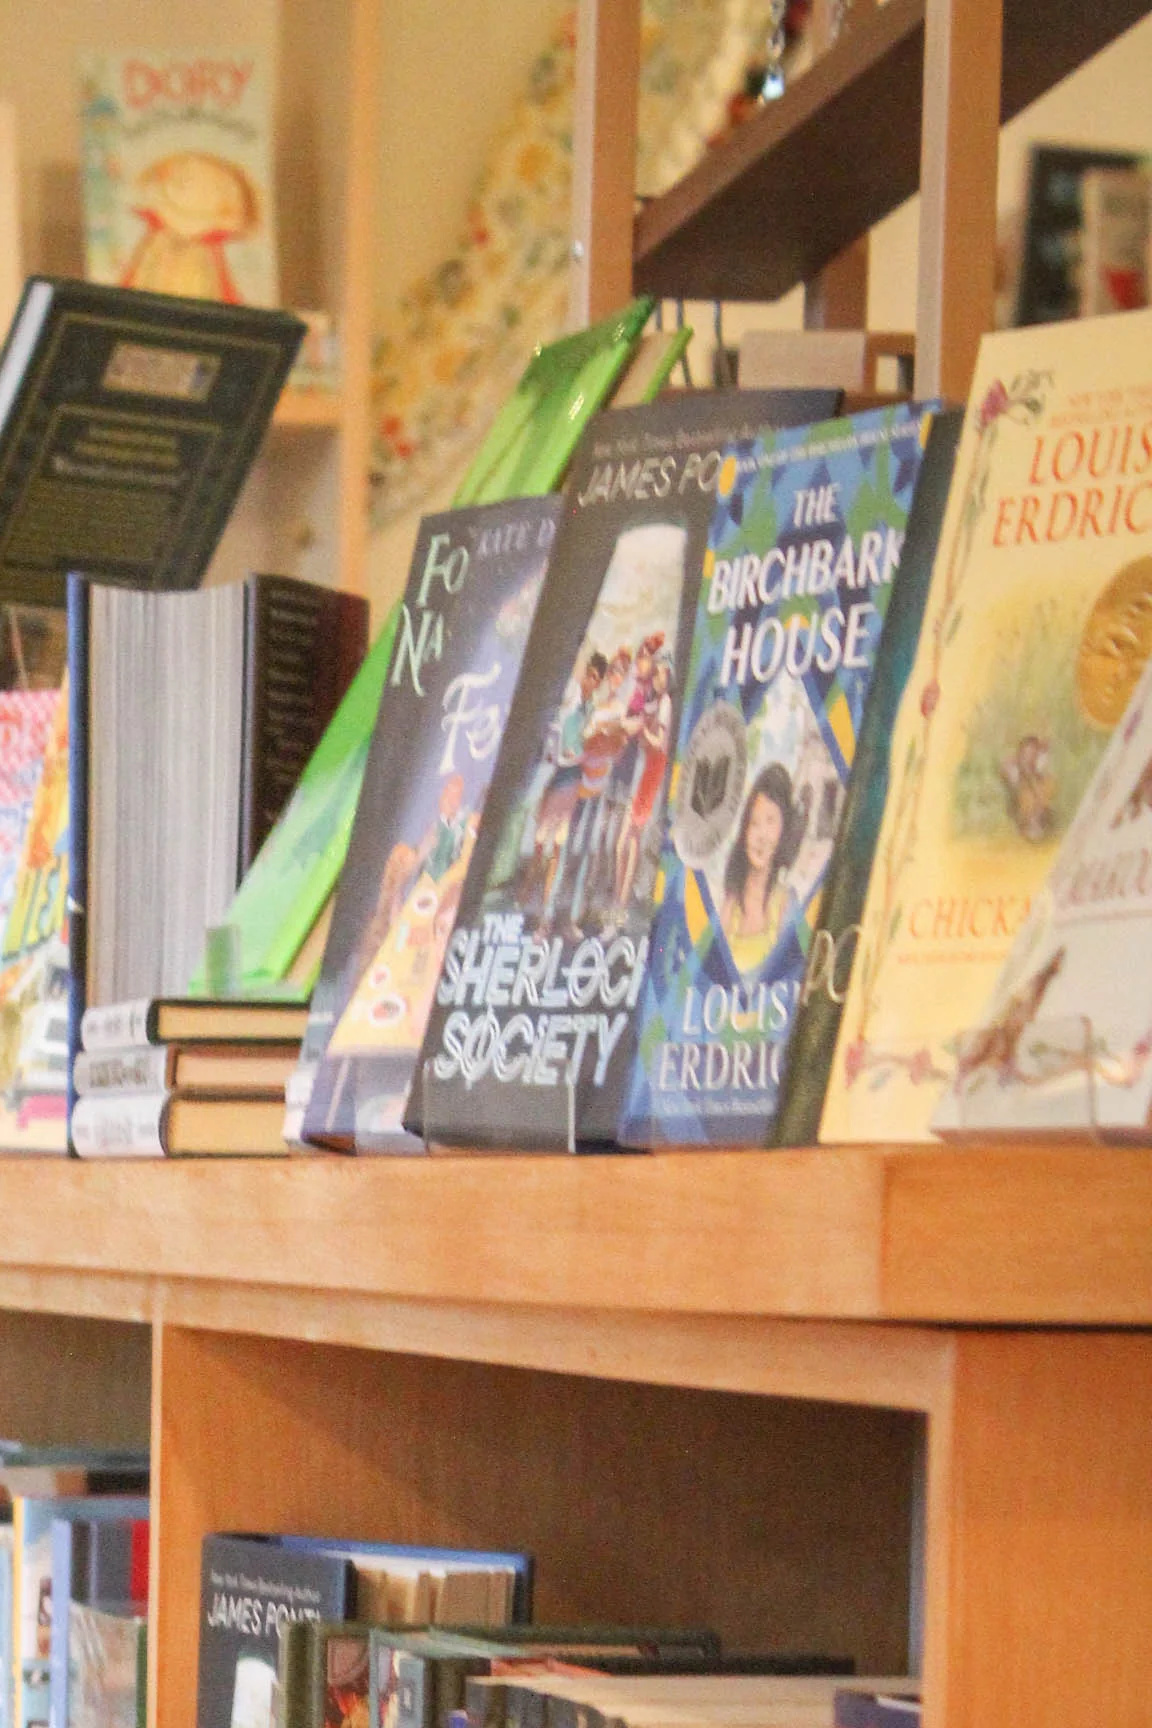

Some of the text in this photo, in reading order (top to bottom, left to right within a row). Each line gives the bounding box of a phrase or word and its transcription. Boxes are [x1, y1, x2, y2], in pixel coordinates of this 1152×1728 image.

[578, 456, 677, 508] JAMES
[793, 482, 840, 527] THE
[719, 601, 878, 687] HOUSE
[481, 912, 525, 945] THE
[683, 980, 801, 1037] LOUIS
[433, 1004, 629, 1092] SOCIETY
[207, 1591, 263, 1636] JAMES
